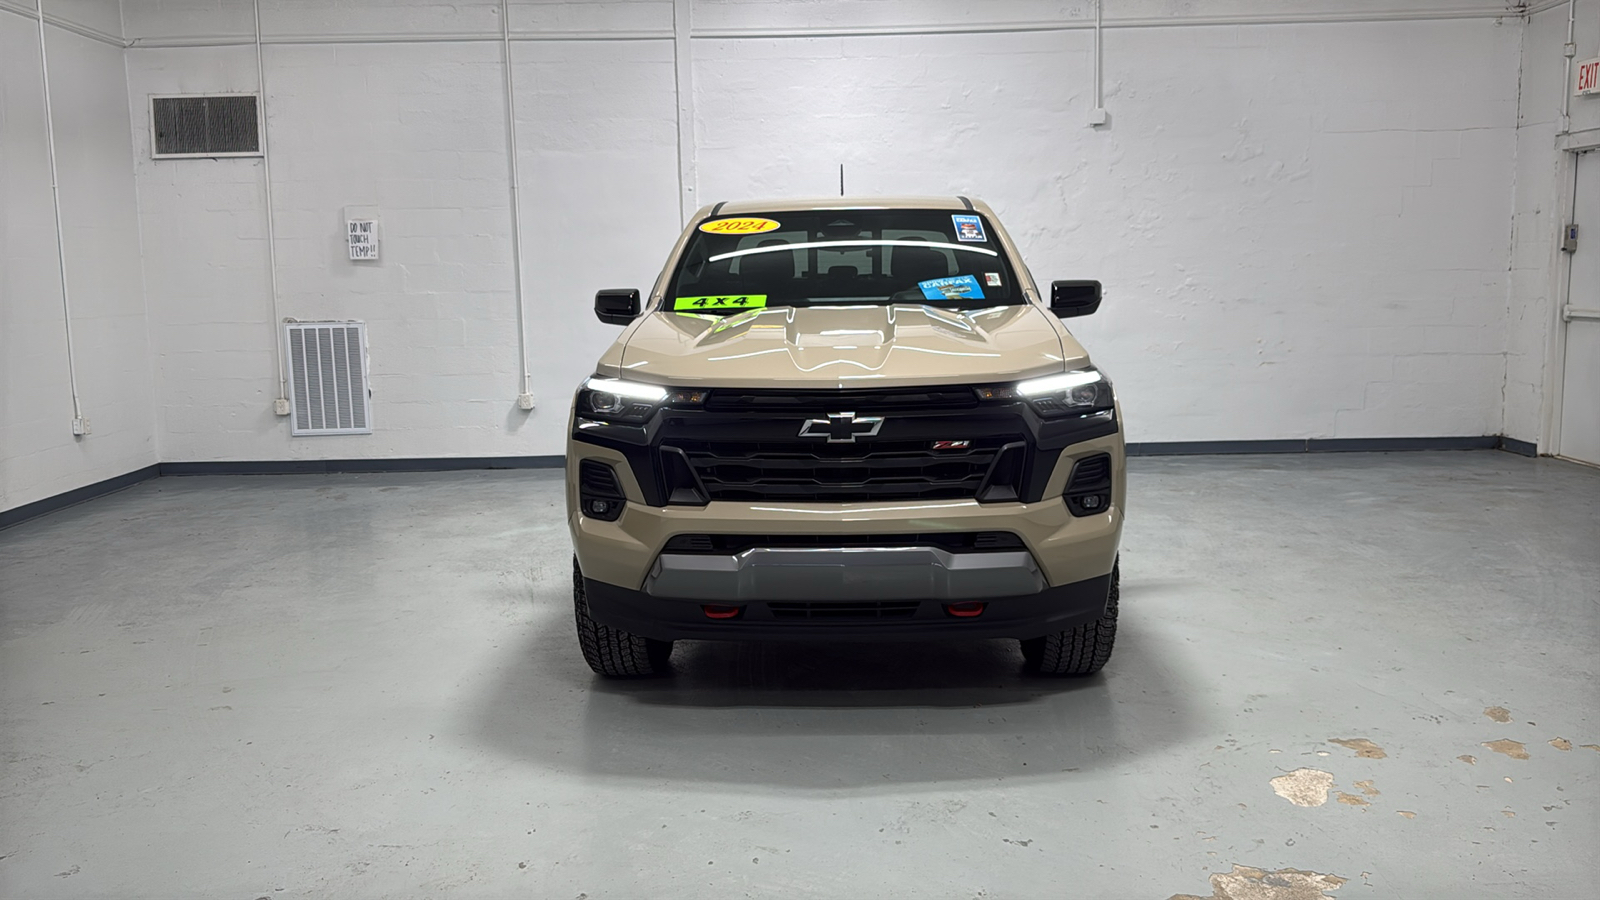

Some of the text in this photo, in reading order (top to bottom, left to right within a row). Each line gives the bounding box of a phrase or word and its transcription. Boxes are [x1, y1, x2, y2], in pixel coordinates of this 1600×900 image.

[1578, 62, 1599, 90] EXIT
[350, 222, 373, 233] DO NOT
[712, 221, 768, 230] 2024
[350, 234, 369, 244] TOUCH
[350, 244, 375, 257] TEMP!!
[923, 278, 972, 288] CARFAX
